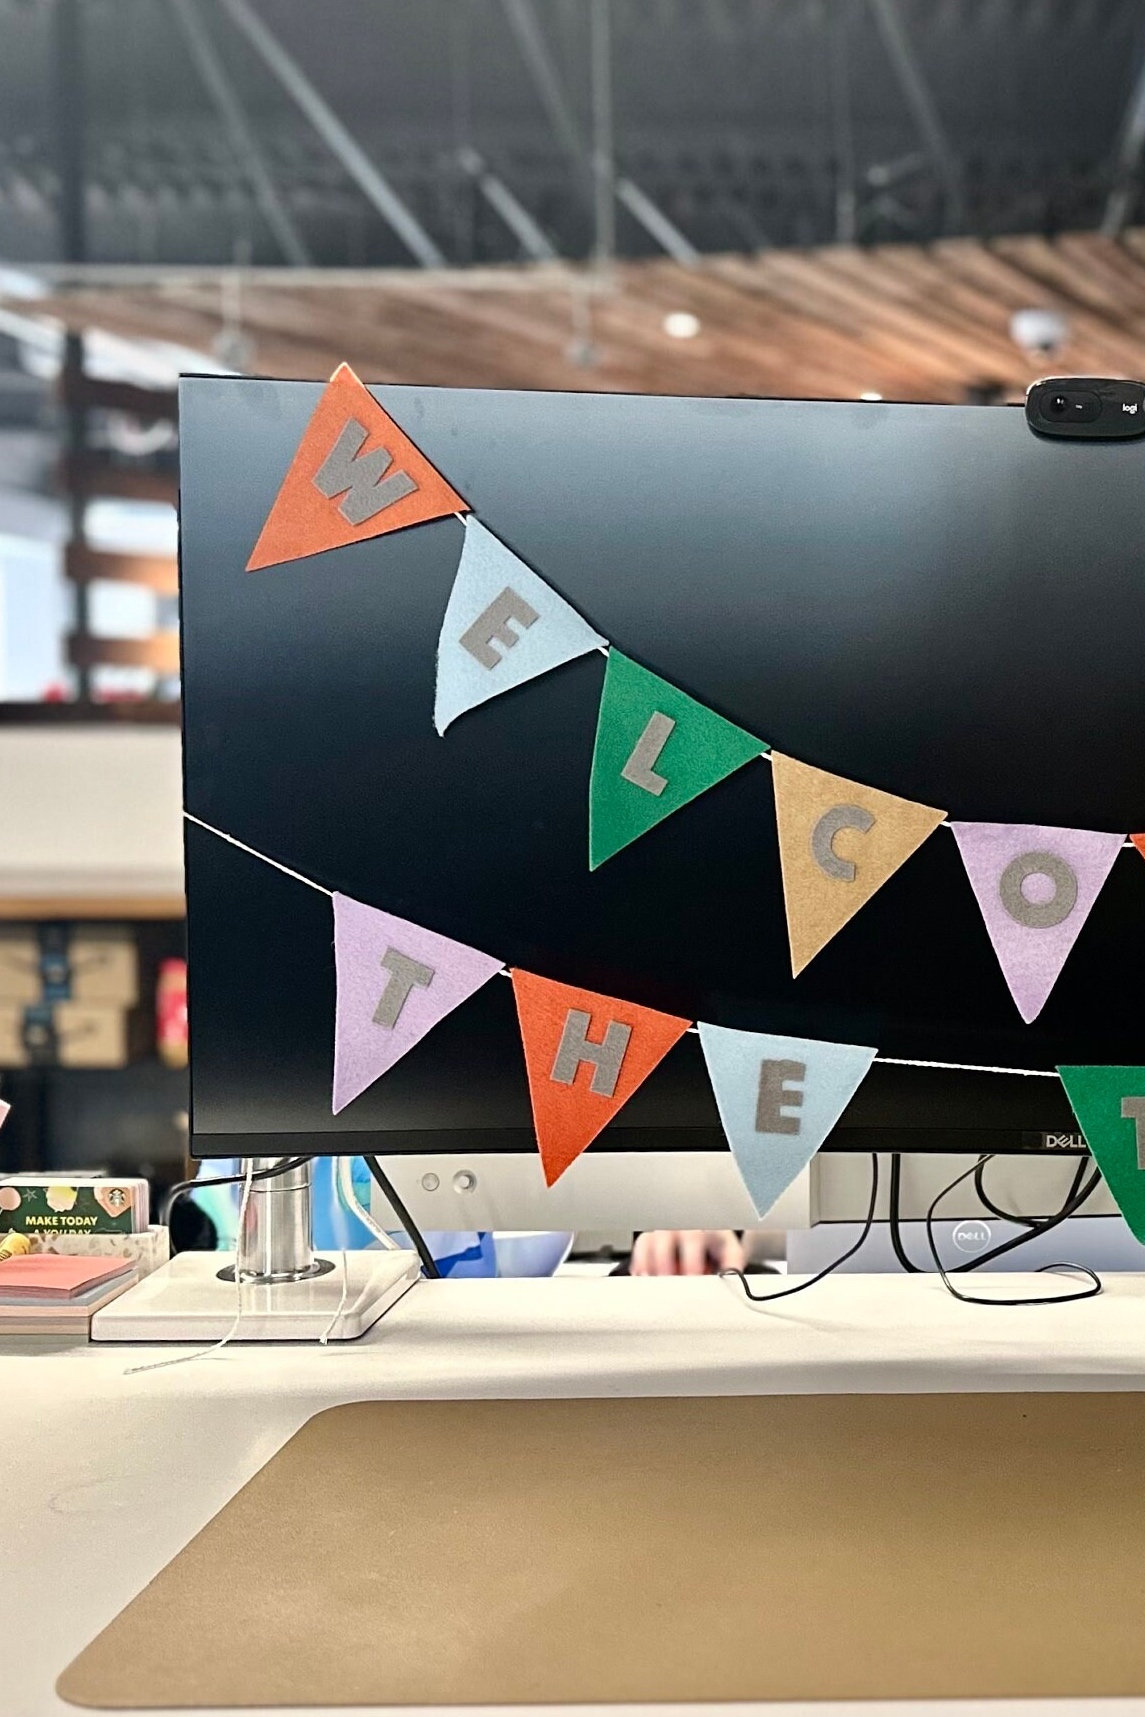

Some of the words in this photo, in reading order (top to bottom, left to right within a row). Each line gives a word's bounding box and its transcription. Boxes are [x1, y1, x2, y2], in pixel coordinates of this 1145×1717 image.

[1122, 403, 1138, 415] logi
[371, 944, 807, 1136] THE
[1046, 1134, 1087, 1148] DELL
[25, 1216, 59, 1226] MAKE
[60, 1216, 98, 1226] TODAY
